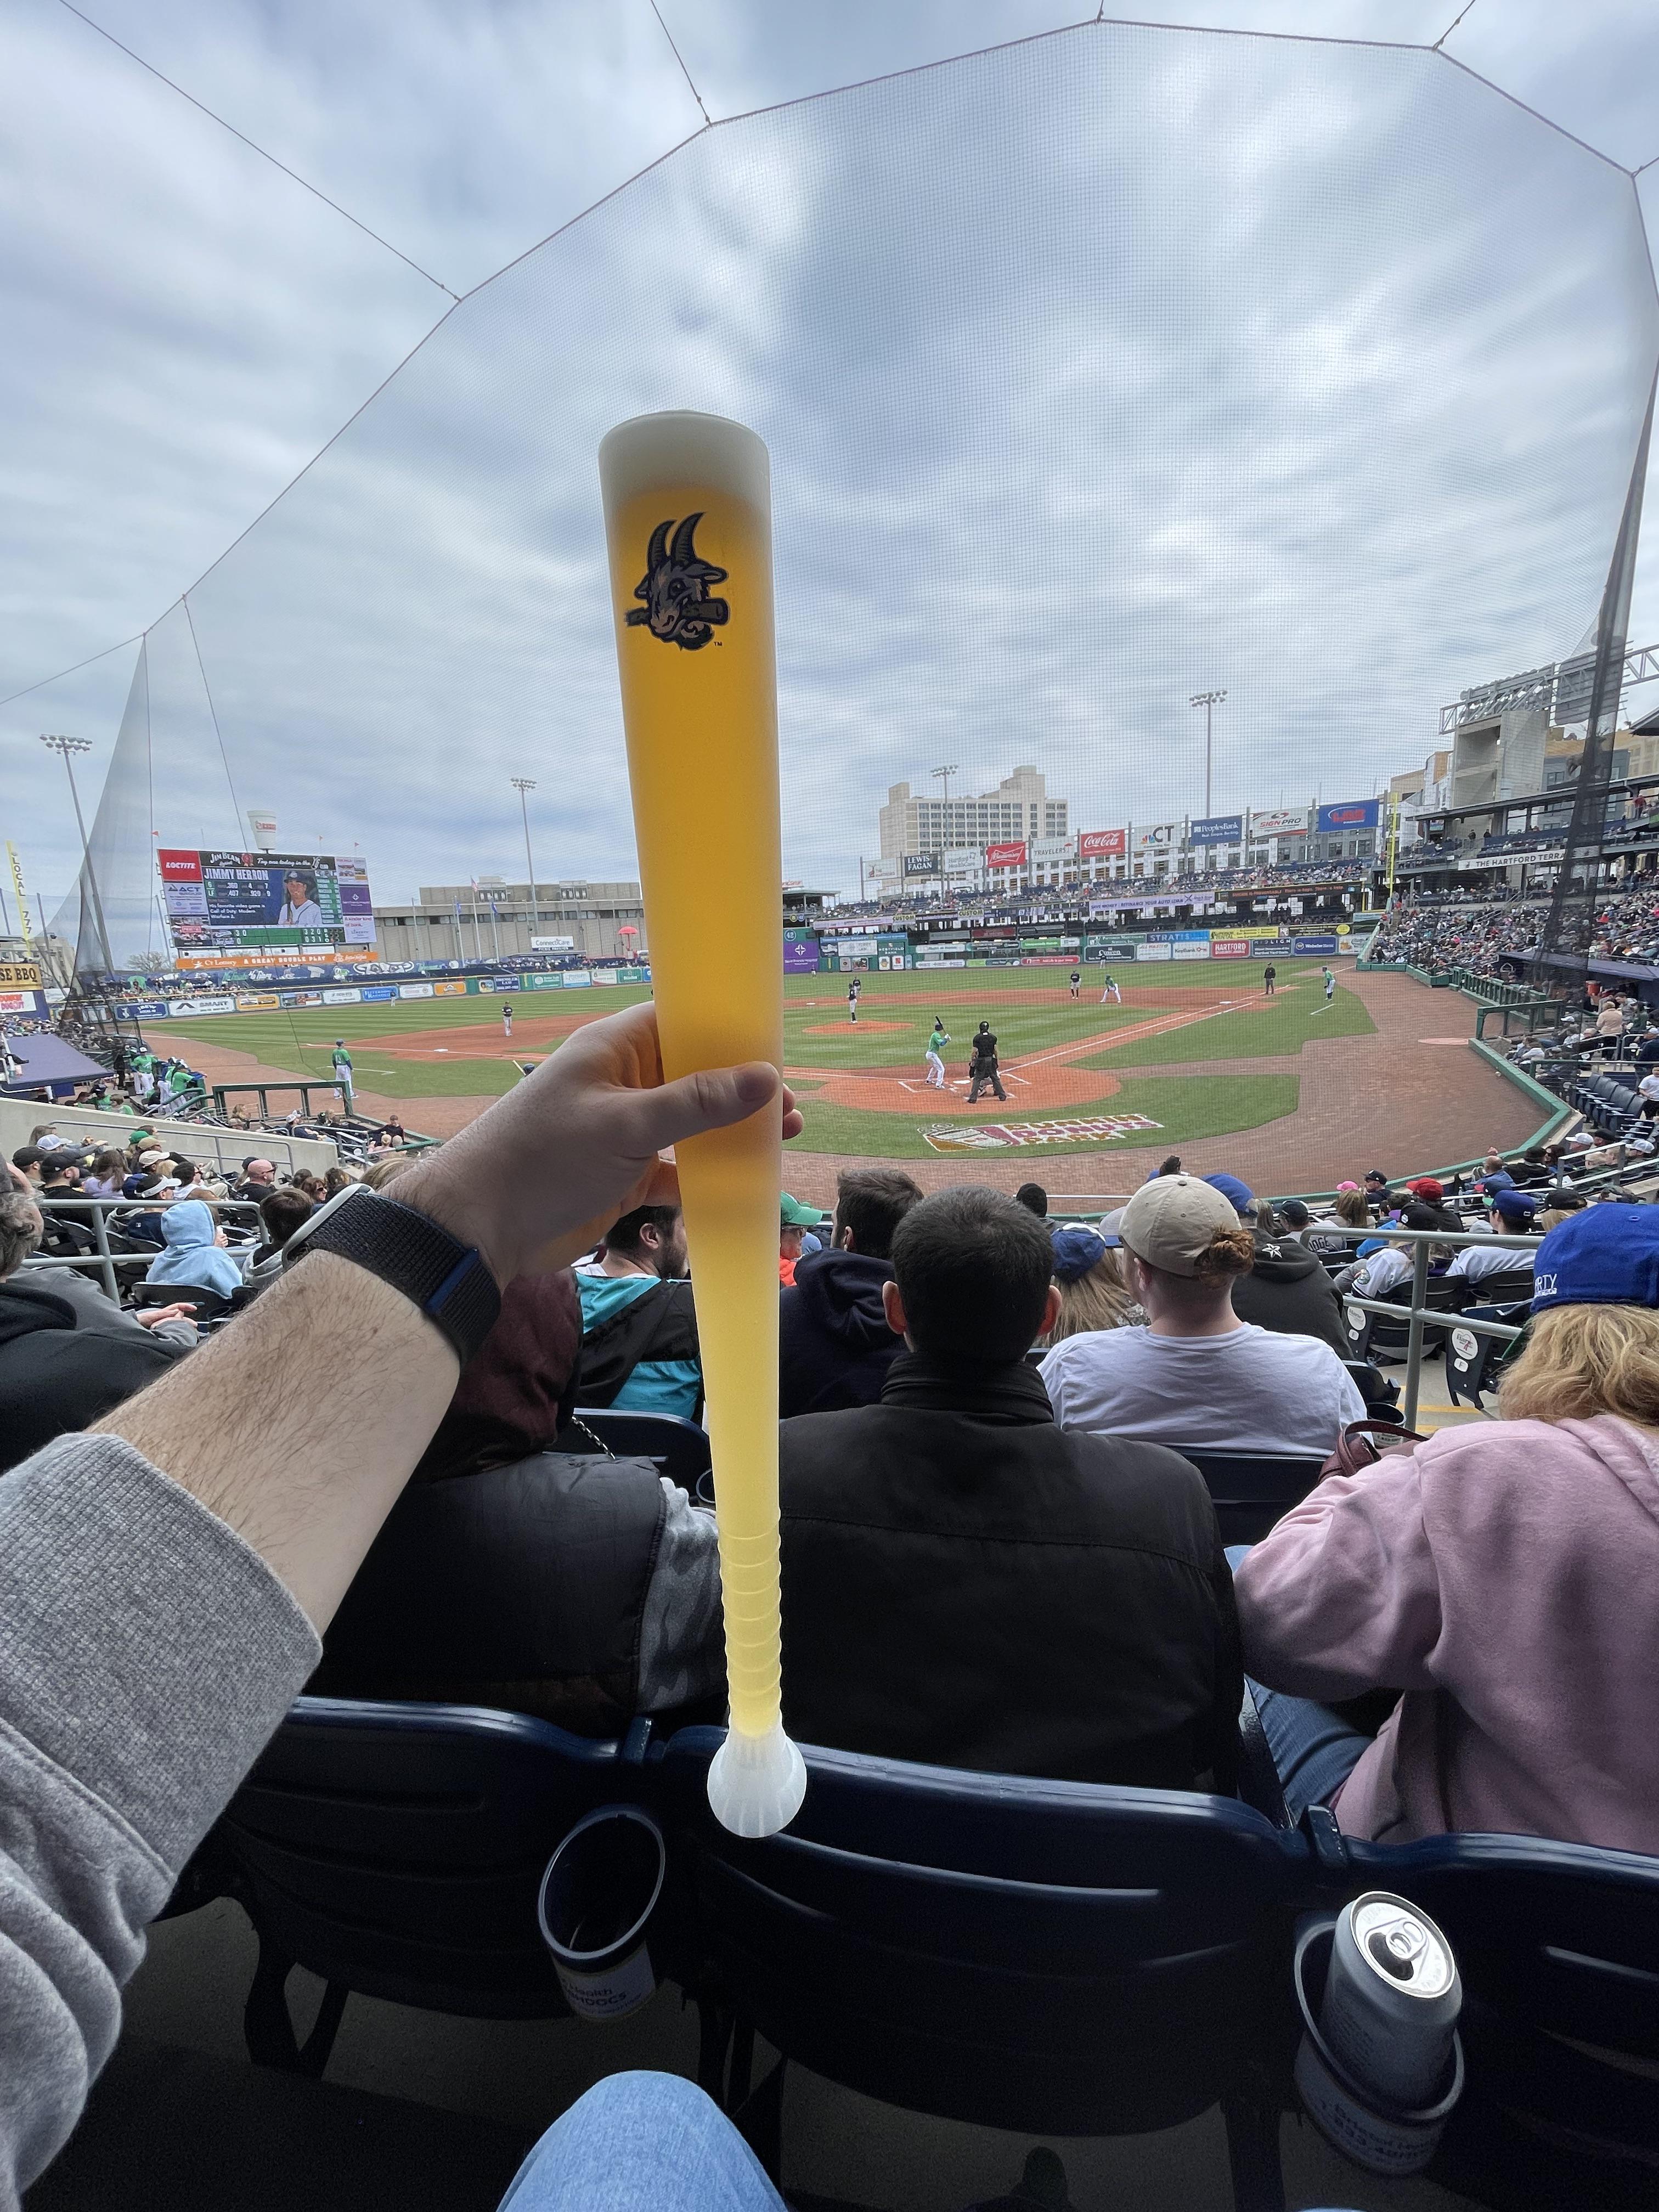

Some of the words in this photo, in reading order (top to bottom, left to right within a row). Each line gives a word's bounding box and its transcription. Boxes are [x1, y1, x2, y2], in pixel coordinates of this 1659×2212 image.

[1201, 822, 1239, 833] PeoplesBank
[1153, 825, 1175, 843] CT
[1034, 848, 1066, 856] TRAVELERS
[210, 854, 222, 864] JIM
[907, 855, 930, 864] LEWIS
[1492, 855, 1537, 866] HARTFORD
[907, 862, 933, 871] FAGAN
[204, 868, 235, 879] JIMMY
[236, 870, 269, 881] HERRON
[535, 938, 570, 946] ConnectiCare
[1150, 933, 1190, 942] STRATIS
[1215, 943, 1246, 951] HARTFORD
[14, 967, 37, 983] BBQ
[1011, 1121, 1159, 1138] DONUTS
[1023, 1131, 1119, 1144] PARK
